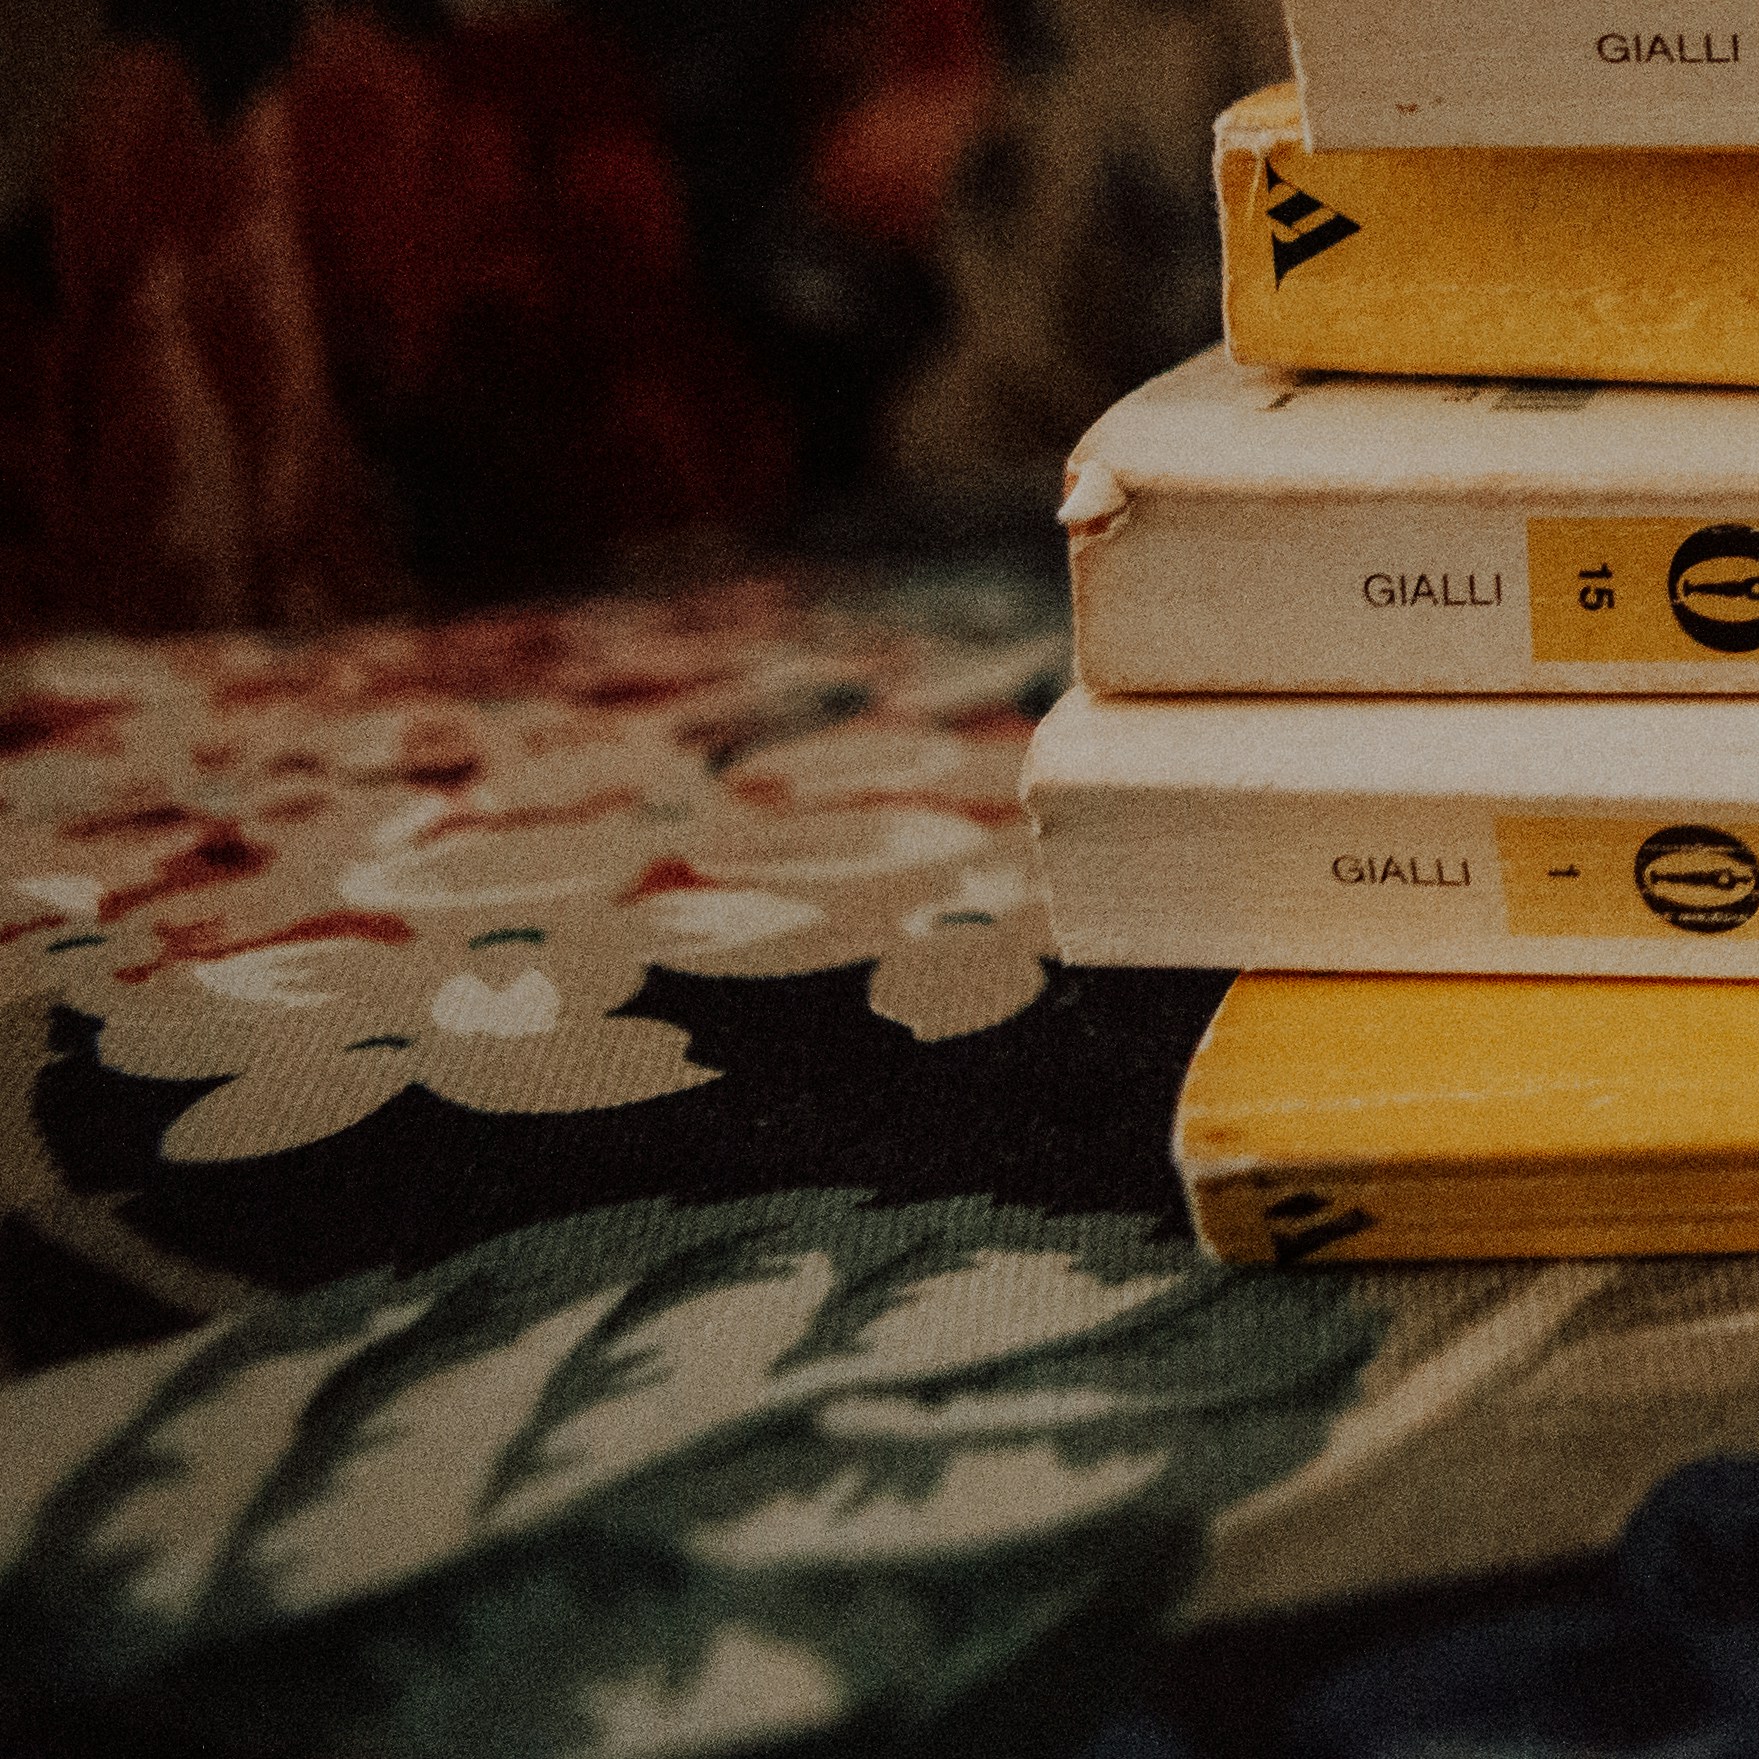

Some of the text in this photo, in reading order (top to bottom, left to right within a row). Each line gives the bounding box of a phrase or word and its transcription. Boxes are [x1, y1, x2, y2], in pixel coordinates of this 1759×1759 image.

[1597, 32, 1741, 65] GIALLI
[1362, 572, 1502, 609] GIALLI
[1577, 563, 1615, 612] 15
[1330, 854, 1471, 888] GIALLI
[1547, 863, 1582, 880] 1
